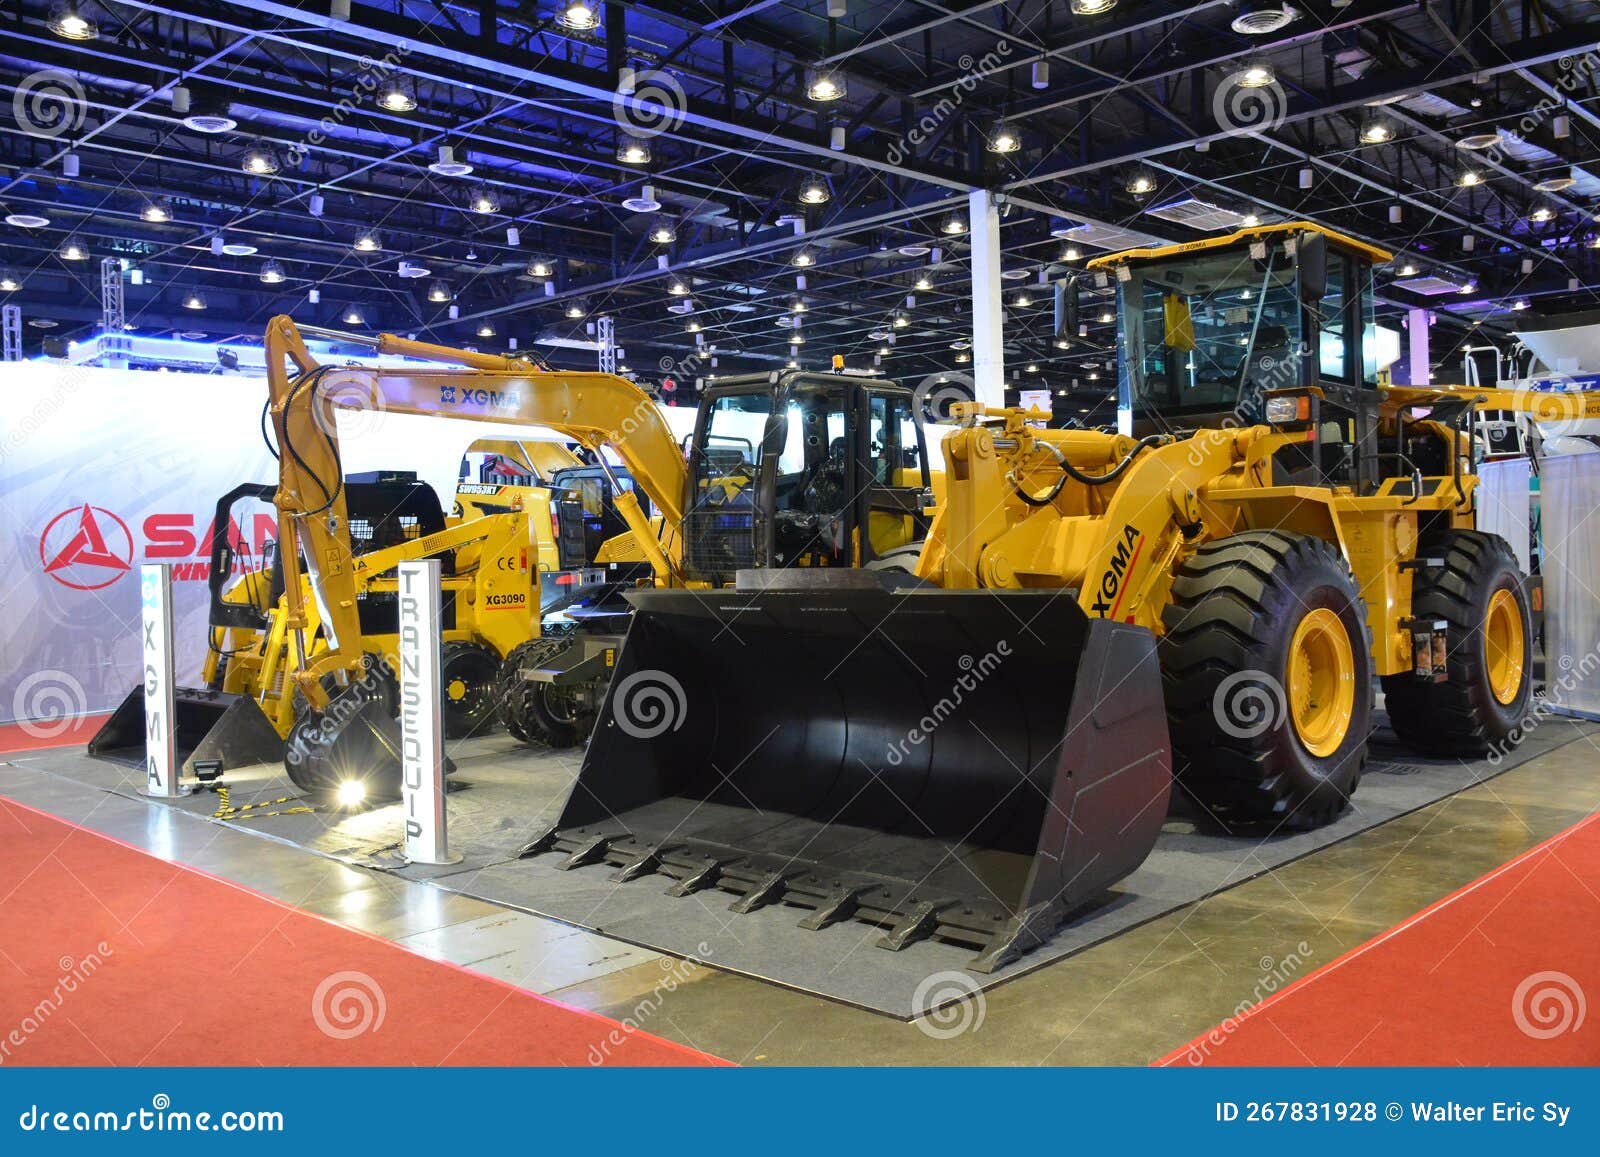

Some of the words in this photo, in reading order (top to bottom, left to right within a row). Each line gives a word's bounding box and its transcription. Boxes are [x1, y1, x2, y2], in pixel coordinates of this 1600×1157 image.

[461, 388, 520, 410] XGMA
[497, 556, 516, 571] CE
[1091, 523, 1141, 619] XGMA
[486, 593, 526, 606] XG3090
[144, 620, 162, 788] XGMA
[400, 569, 424, 843] TRANSEQUIP
